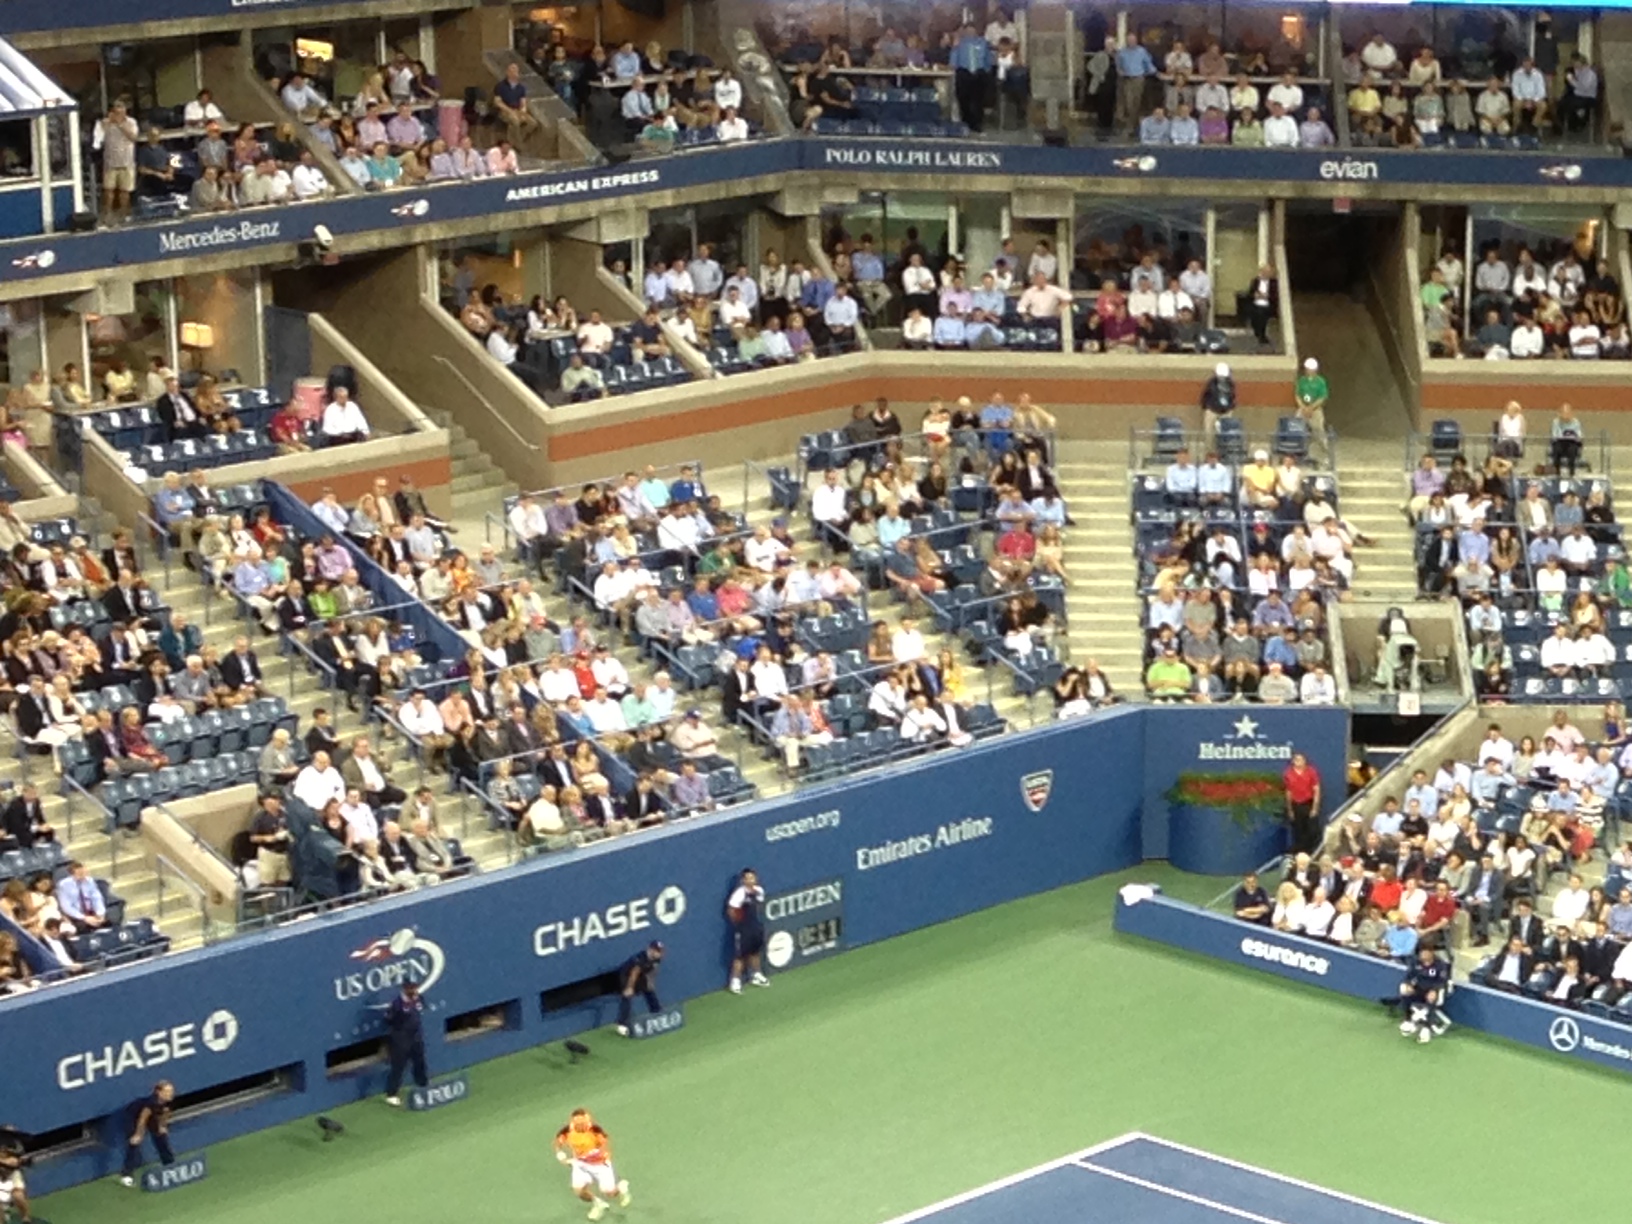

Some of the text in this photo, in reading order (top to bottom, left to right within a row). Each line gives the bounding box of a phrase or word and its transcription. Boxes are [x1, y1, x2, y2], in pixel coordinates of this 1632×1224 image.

[826, 148, 1001, 167] POLO RALPH LAUREN
[1320, 156, 1378, 178] evian
[506, 169, 659, 201] AMERICAN EXPRESS
[160, 221, 279, 252] Mercedes-Benz
[1199, 742, 1292, 759] Heineken
[765, 809, 840, 841] usopen.org
[856, 816, 992, 870] Emirates Airline
[765, 881, 841, 920] CITIZEN
[533, 897, 651, 956] CHASE
[1241, 937, 1328, 975] esurance
[334, 954, 429, 1000] US OPEN
[646, 1011, 682, 1035] POLO
[57, 1023, 197, 1089] CHASE
[427, 1081, 465, 1105] POLO
[162, 1161, 203, 1187] POLO
